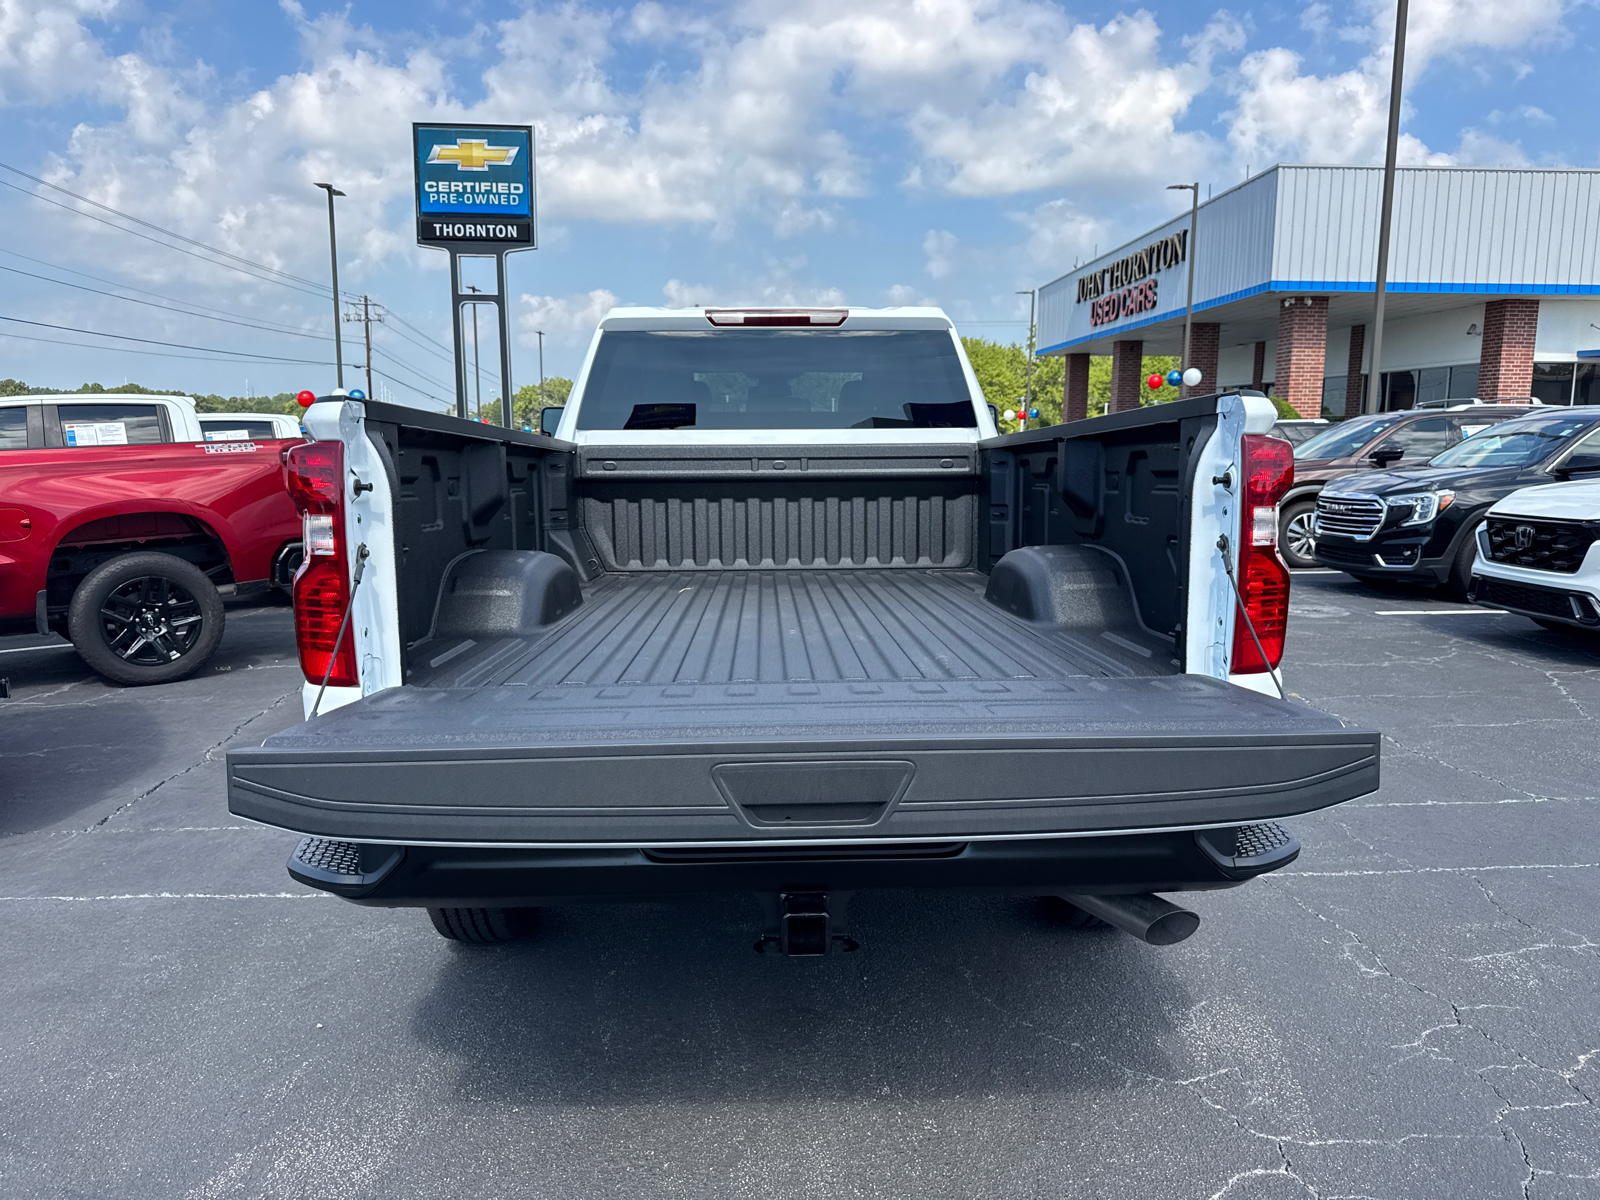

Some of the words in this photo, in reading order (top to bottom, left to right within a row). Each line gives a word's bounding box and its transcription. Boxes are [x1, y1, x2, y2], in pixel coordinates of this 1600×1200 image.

[424, 181, 524, 194] CERTIFIED
[429, 193, 519, 205] PRE-OWNED
[433, 223, 518, 238] THORNTON
[1075, 268, 1106, 304] JOHN
[1106, 229, 1189, 292] THORNTON
[1089, 294, 1120, 327] USED
[1120, 279, 1158, 317] CARS
